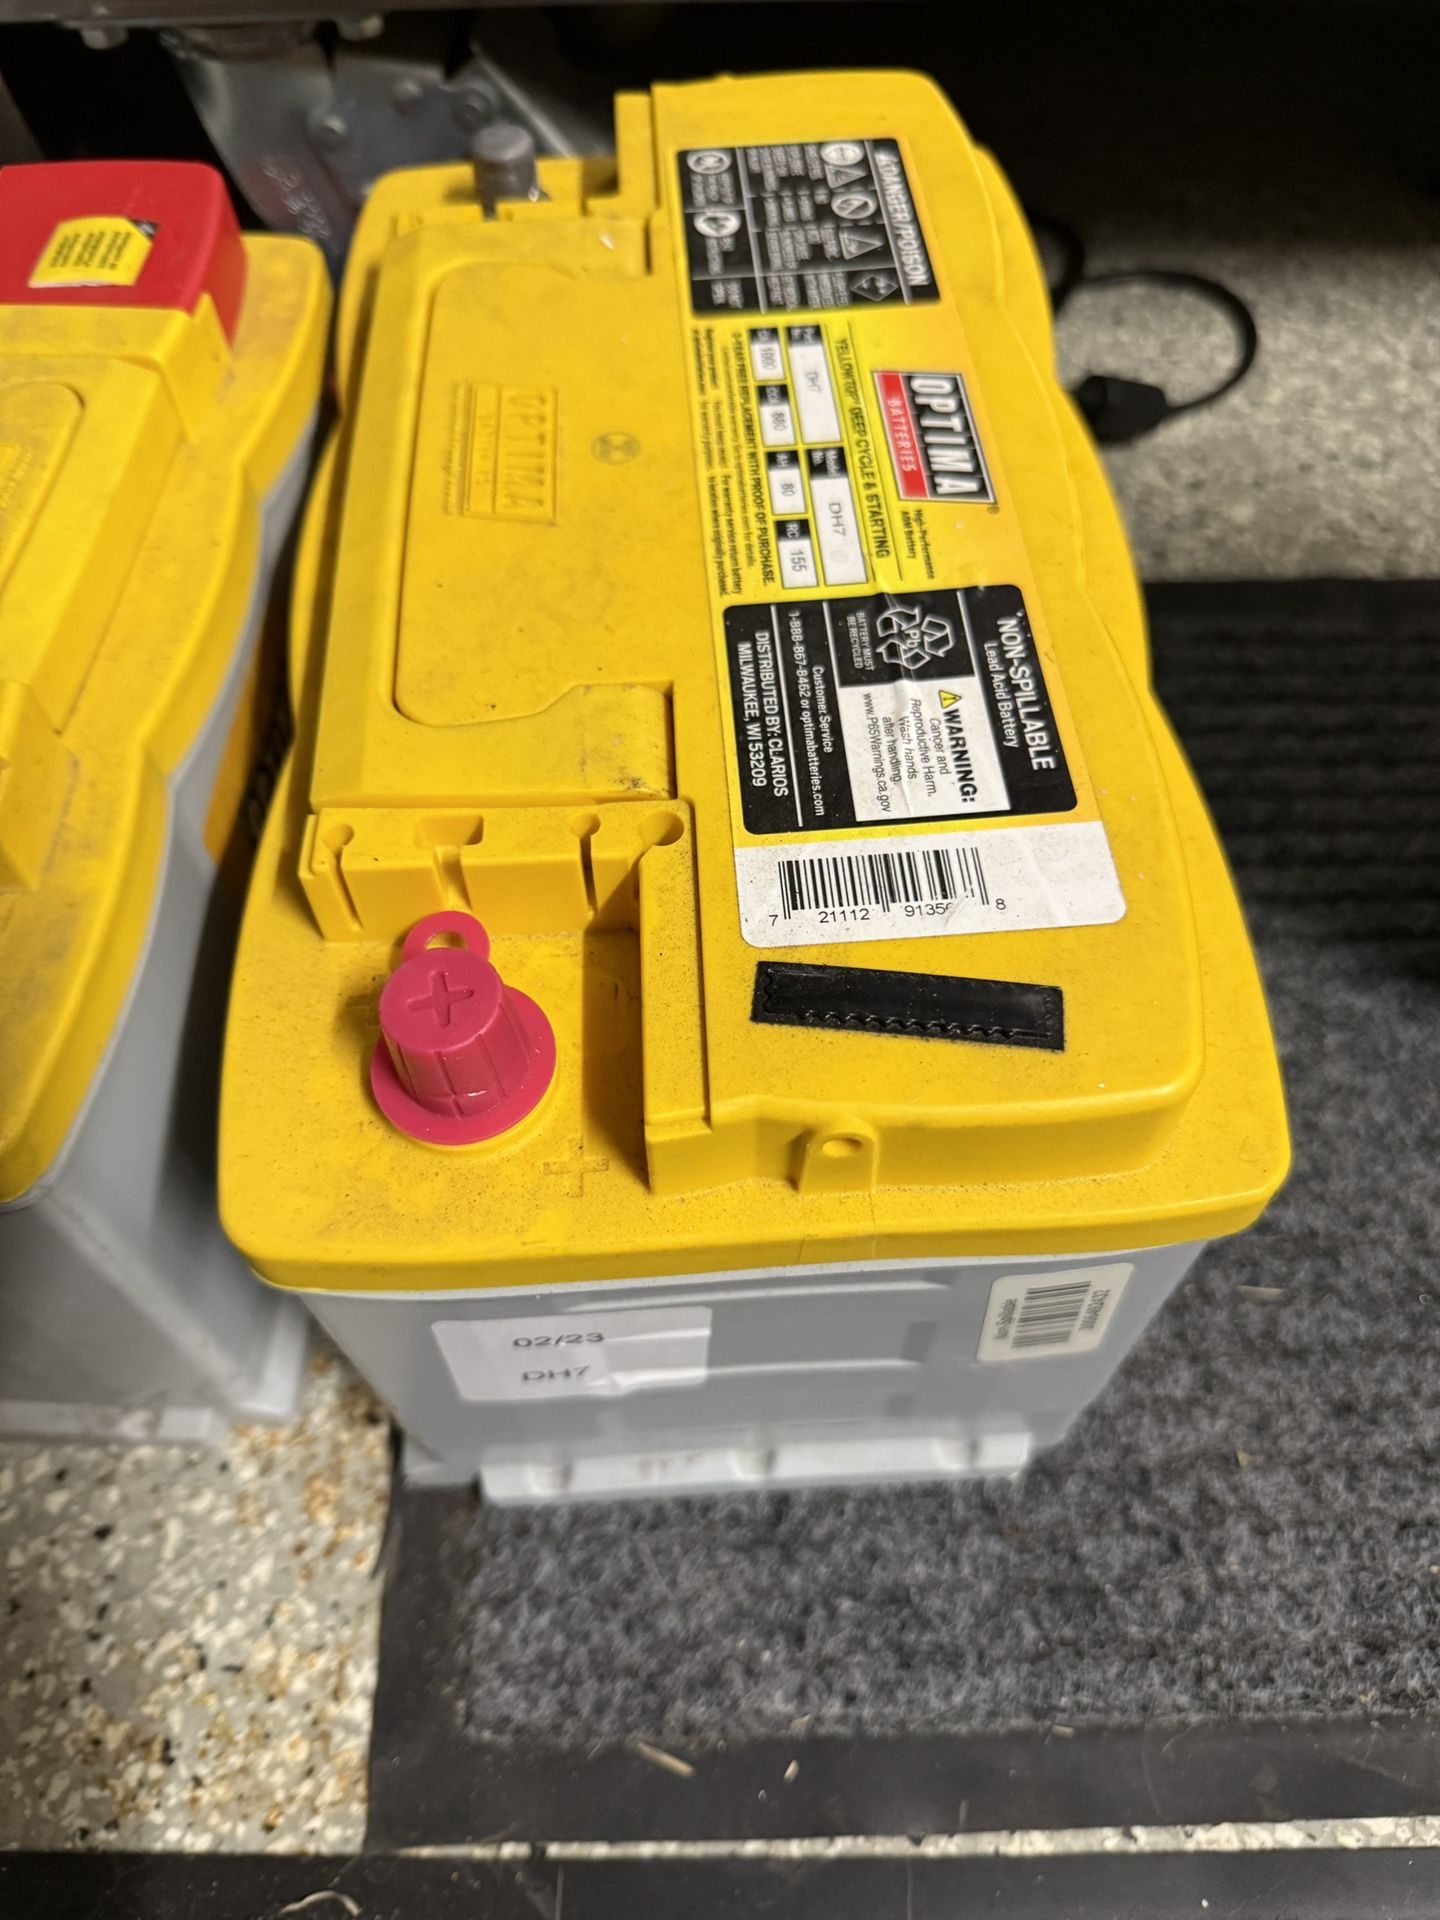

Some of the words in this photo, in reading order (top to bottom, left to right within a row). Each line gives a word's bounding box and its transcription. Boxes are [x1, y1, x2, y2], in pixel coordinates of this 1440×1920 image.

[738, 384, 757, 449] REPLACEMENT
[772, 412, 788, 432] 880
[848, 406, 868, 438] DEEP
[887, 399, 917, 472] BATTERIES
[909, 376, 983, 495] OPTIMA
[748, 451, 760, 476] WITH
[776, 454, 789, 468] AH
[825, 451, 840, 475] Model
[855, 439, 876, 480] CYCLE
[750, 477, 765, 511] PROOF
[780, 482, 796, 496] 80
[863, 482, 876, 491] &
[726, 518, 738, 545] service
[755, 512, 767, 525] OF
[786, 523, 800, 538] RC
[828, 502, 846, 537] DH7
[866, 494, 891, 559] STARTING
[756, 527, 775, 587] PURCHASE.
[903, 531, 917, 559] Battery
[913, 509, 935, 580] High-Performance
[790, 550, 808, 572] 155
[731, 567, 743, 595] battery
[847, 616, 858, 627] BE
[856, 612, 871, 648] BATTERY
[788, 610, 810, 697] 1-888-867-8462
[849, 627, 863, 668] RECYCLED
[904, 629, 921, 648] Pb
[755, 630, 778, 714] DISTRIBUTED
[863, 648, 875, 671] MUST
[983, 643, 1001, 671] Lead
[737, 642, 760, 722] MILWAUKEE,
[811, 665, 828, 714] Customer
[990, 674, 1008, 700] Acid
[996, 618, 1056, 770] NON-SPILLABLE
[800, 699, 810, 709] or
[745, 723, 763, 740] WI
[765, 716, 782, 737] BY:
[818, 716, 834, 753] Service
[881, 717, 896, 738] after
[897, 716, 912, 745] Wash
[997, 702, 1020, 748] Battery
[862, 692, 892, 814] www.P65Warnings.ca.gov
[910, 698, 931, 764] Reproductive
[923, 766, 938, 797] Harm.
[928, 718, 945, 753] Cancer
[937, 756, 952, 775] and
[943, 709, 977, 803] WARNING:
[748, 742, 768, 787] 53209
[767, 738, 789, 797] CLARIOS
[799, 711, 825, 816] optimabatteries.com
[886, 741, 903, 785] handling.
[903, 748, 918, 779] hands
[768, 914, 779, 927] 7
[818, 908, 871, 924] 21112
[995, 898, 1007, 910] 8
[512, 1332, 605, 1347] 02/23
[522, 1365, 590, 1382] DH7
